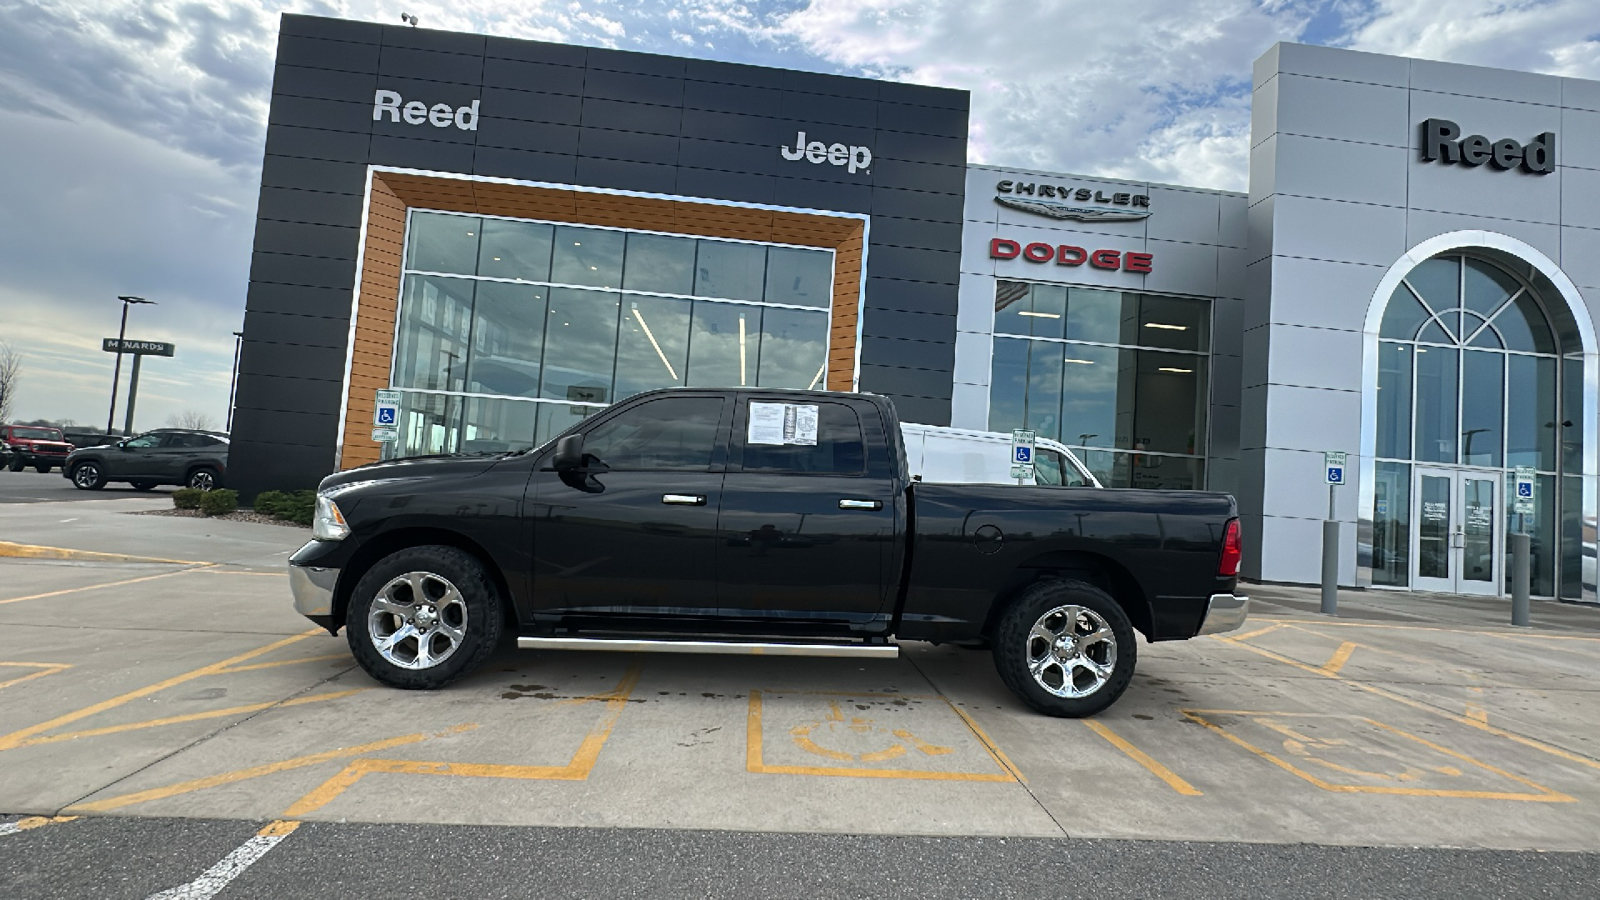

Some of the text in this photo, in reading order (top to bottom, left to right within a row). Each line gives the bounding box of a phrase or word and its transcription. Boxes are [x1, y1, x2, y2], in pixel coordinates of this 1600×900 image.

[373, 89, 480, 131] Reed
[781, 131, 872, 174] Jeep
[1422, 117, 1556, 173] Reed
[996, 180, 1151, 207] CHRYSLER
[989, 238, 1154, 273] DODGE
[107, 340, 164, 351] MNARDS
